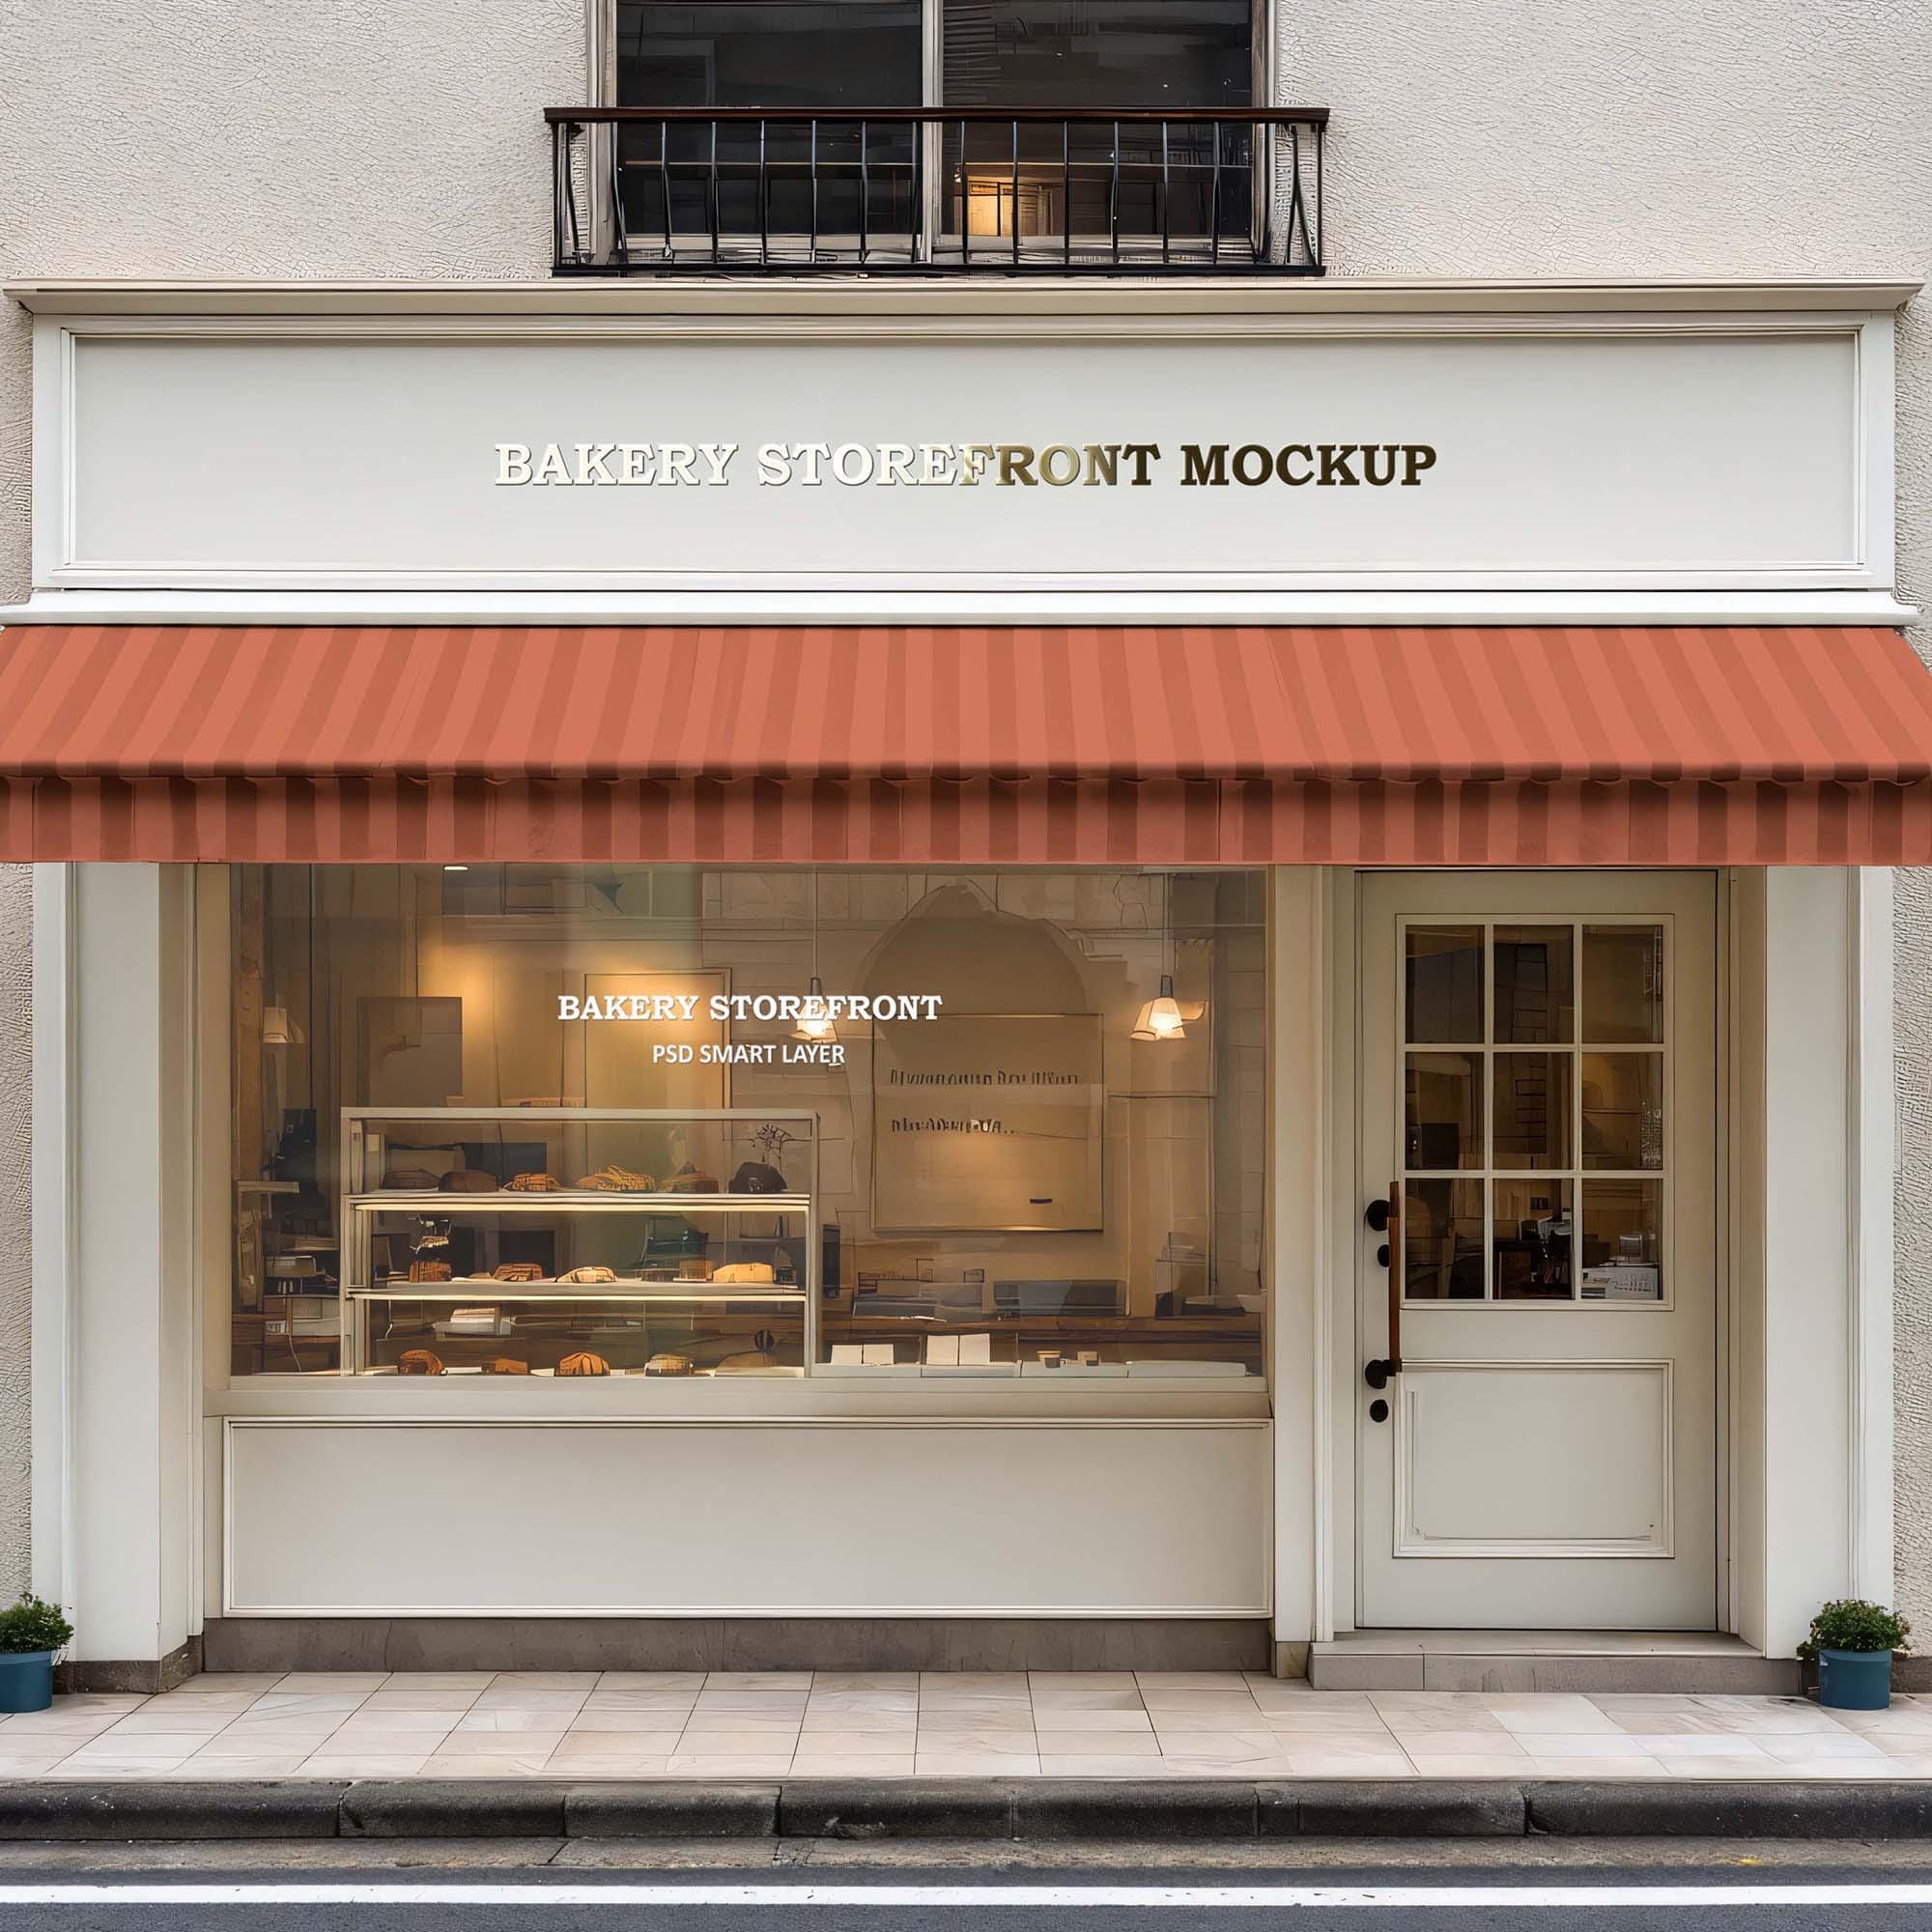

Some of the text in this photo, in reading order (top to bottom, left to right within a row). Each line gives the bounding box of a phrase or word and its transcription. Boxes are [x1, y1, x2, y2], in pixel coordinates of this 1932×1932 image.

[494, 442, 1438, 488] BAKERY STOREFRONT MOCKUP
[557, 994, 944, 1021] BAKERY STOREFRONT
[652, 1044, 846, 1065] PSD SMART LAYER
